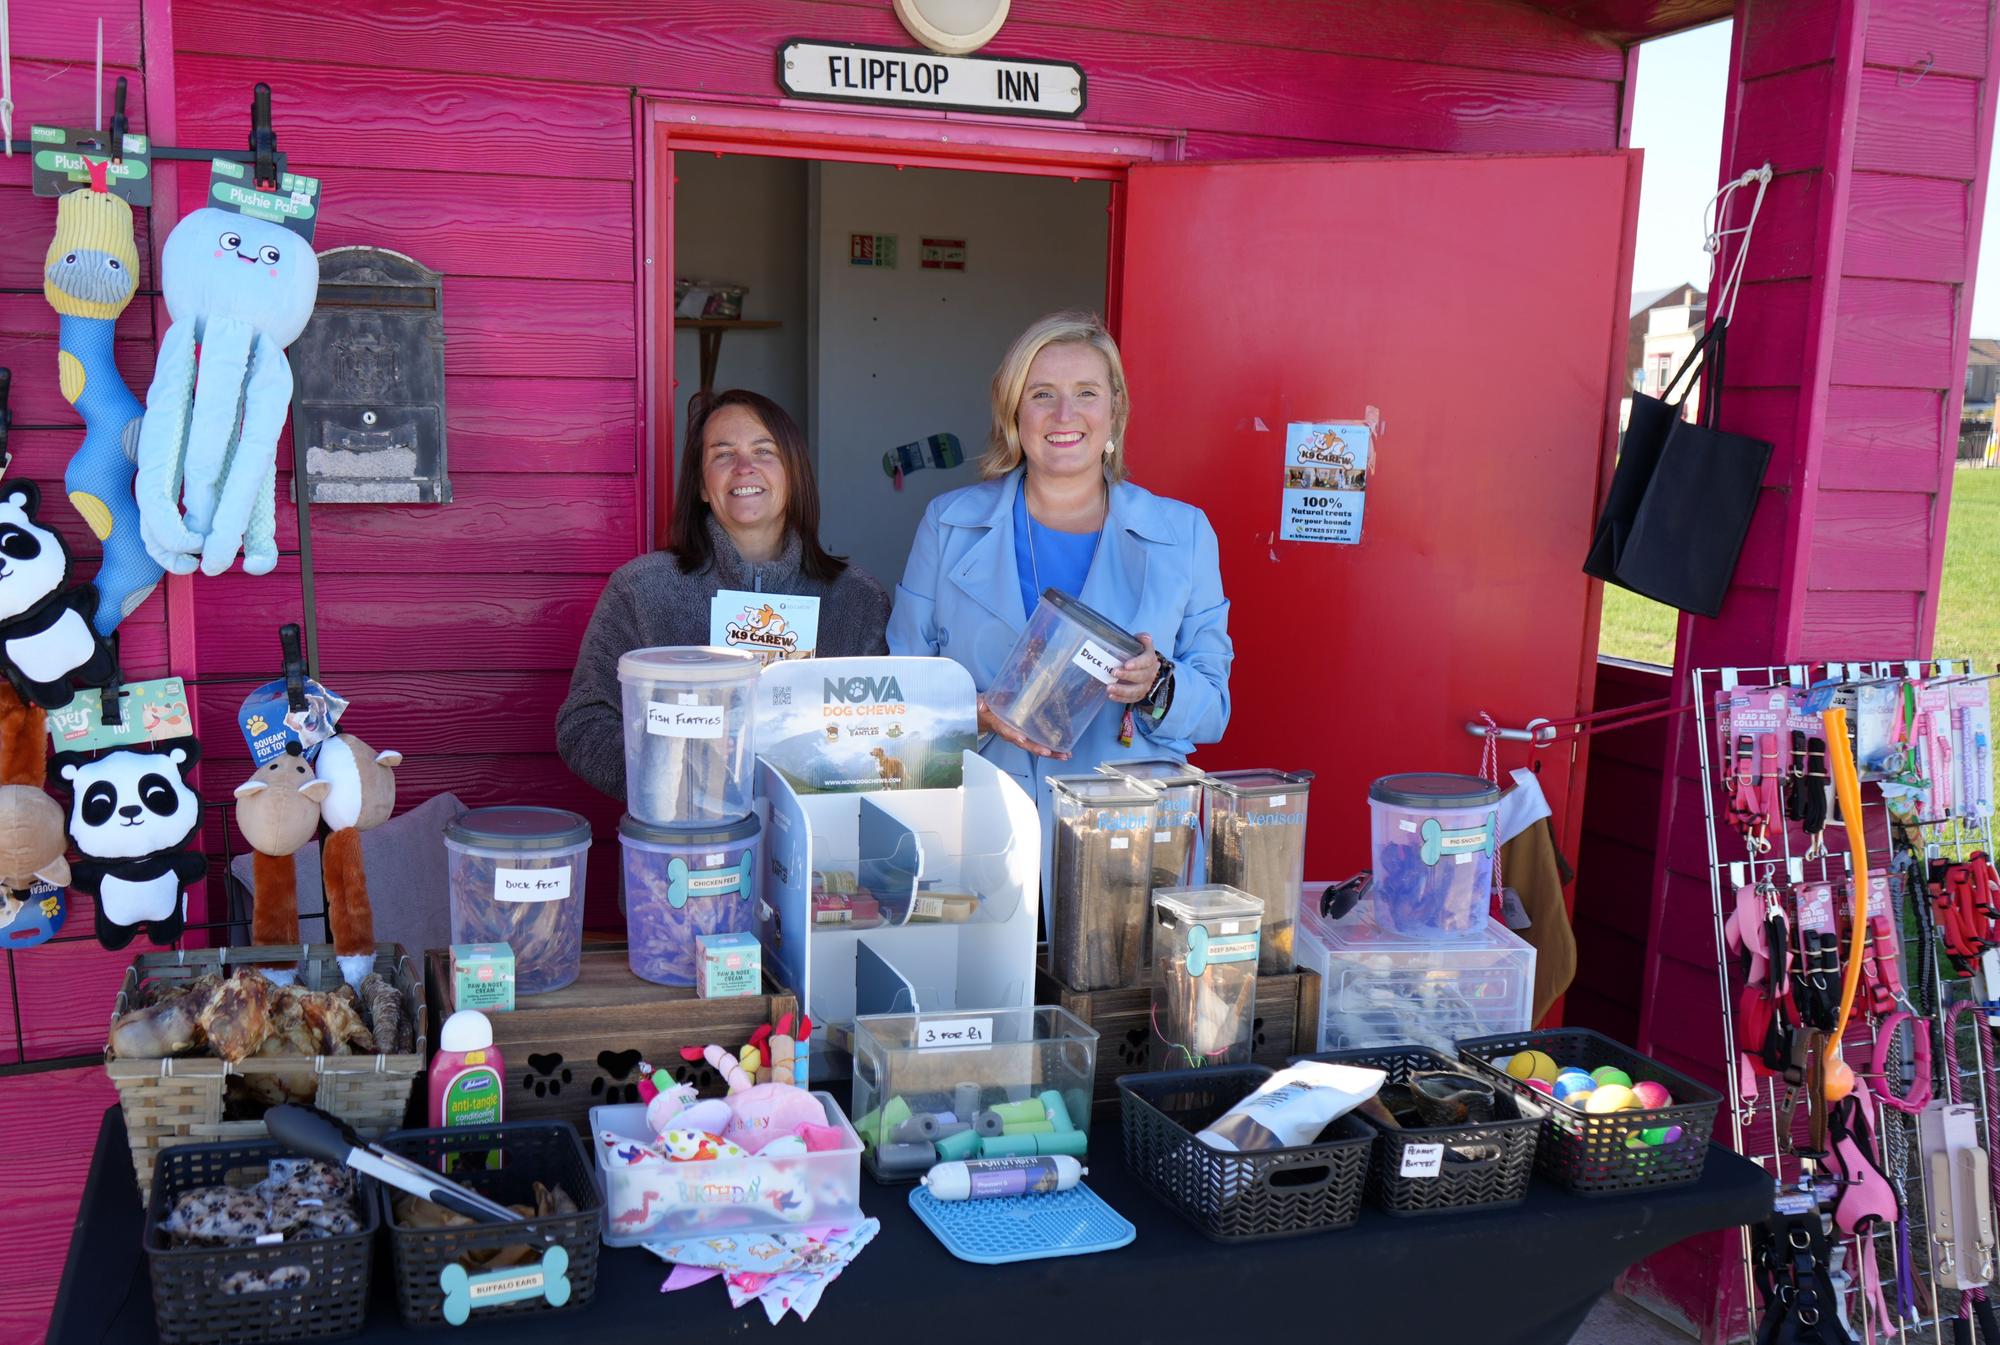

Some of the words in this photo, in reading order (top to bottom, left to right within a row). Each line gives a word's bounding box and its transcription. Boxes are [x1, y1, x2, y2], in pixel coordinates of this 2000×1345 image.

[828, 55, 949, 95] FLIPFLOP
[997, 69, 1040, 102] INN
[230, 188, 271, 209] Plushie
[274, 199, 298, 215] Pals
[1301, 450, 1315, 461] K9
[1316, 452, 1351, 466] CAREW
[1291, 507, 1324, 516] Natural
[1303, 497, 1343, 509] 100%
[731, 629, 748, 640] K9
[749, 632, 794, 646] CAREW
[1080, 647, 1103, 668] DUCK
[823, 676, 905, 704] NOVA
[823, 704, 853, 718] DOG
[856, 704, 906, 716] CHEWS
[1734, 720, 1765, 728] COLLAR
[1766, 720, 1781, 728] SET
[253, 730, 287, 750] SQUEAKY
[256, 746, 272, 758] FOX
[272, 740, 287, 752] TOY
[1097, 811, 1148, 832] Rabbit
[1247, 811, 1305, 826] Venison
[693, 879, 723, 888] CHICKEN
[723, 876, 737, 885] FEET
[1209, 946, 1225, 954] BEEF
[924, 1030, 936, 1042] 3
[452, 1093, 498, 1113] anti-tangle
[455, 1108, 495, 1121] conditioning
[677, 1175, 761, 1205] BIRTHDAY
[476, 1282, 514, 1295] BUFFALO
[516, 1277, 538, 1288] EARS
